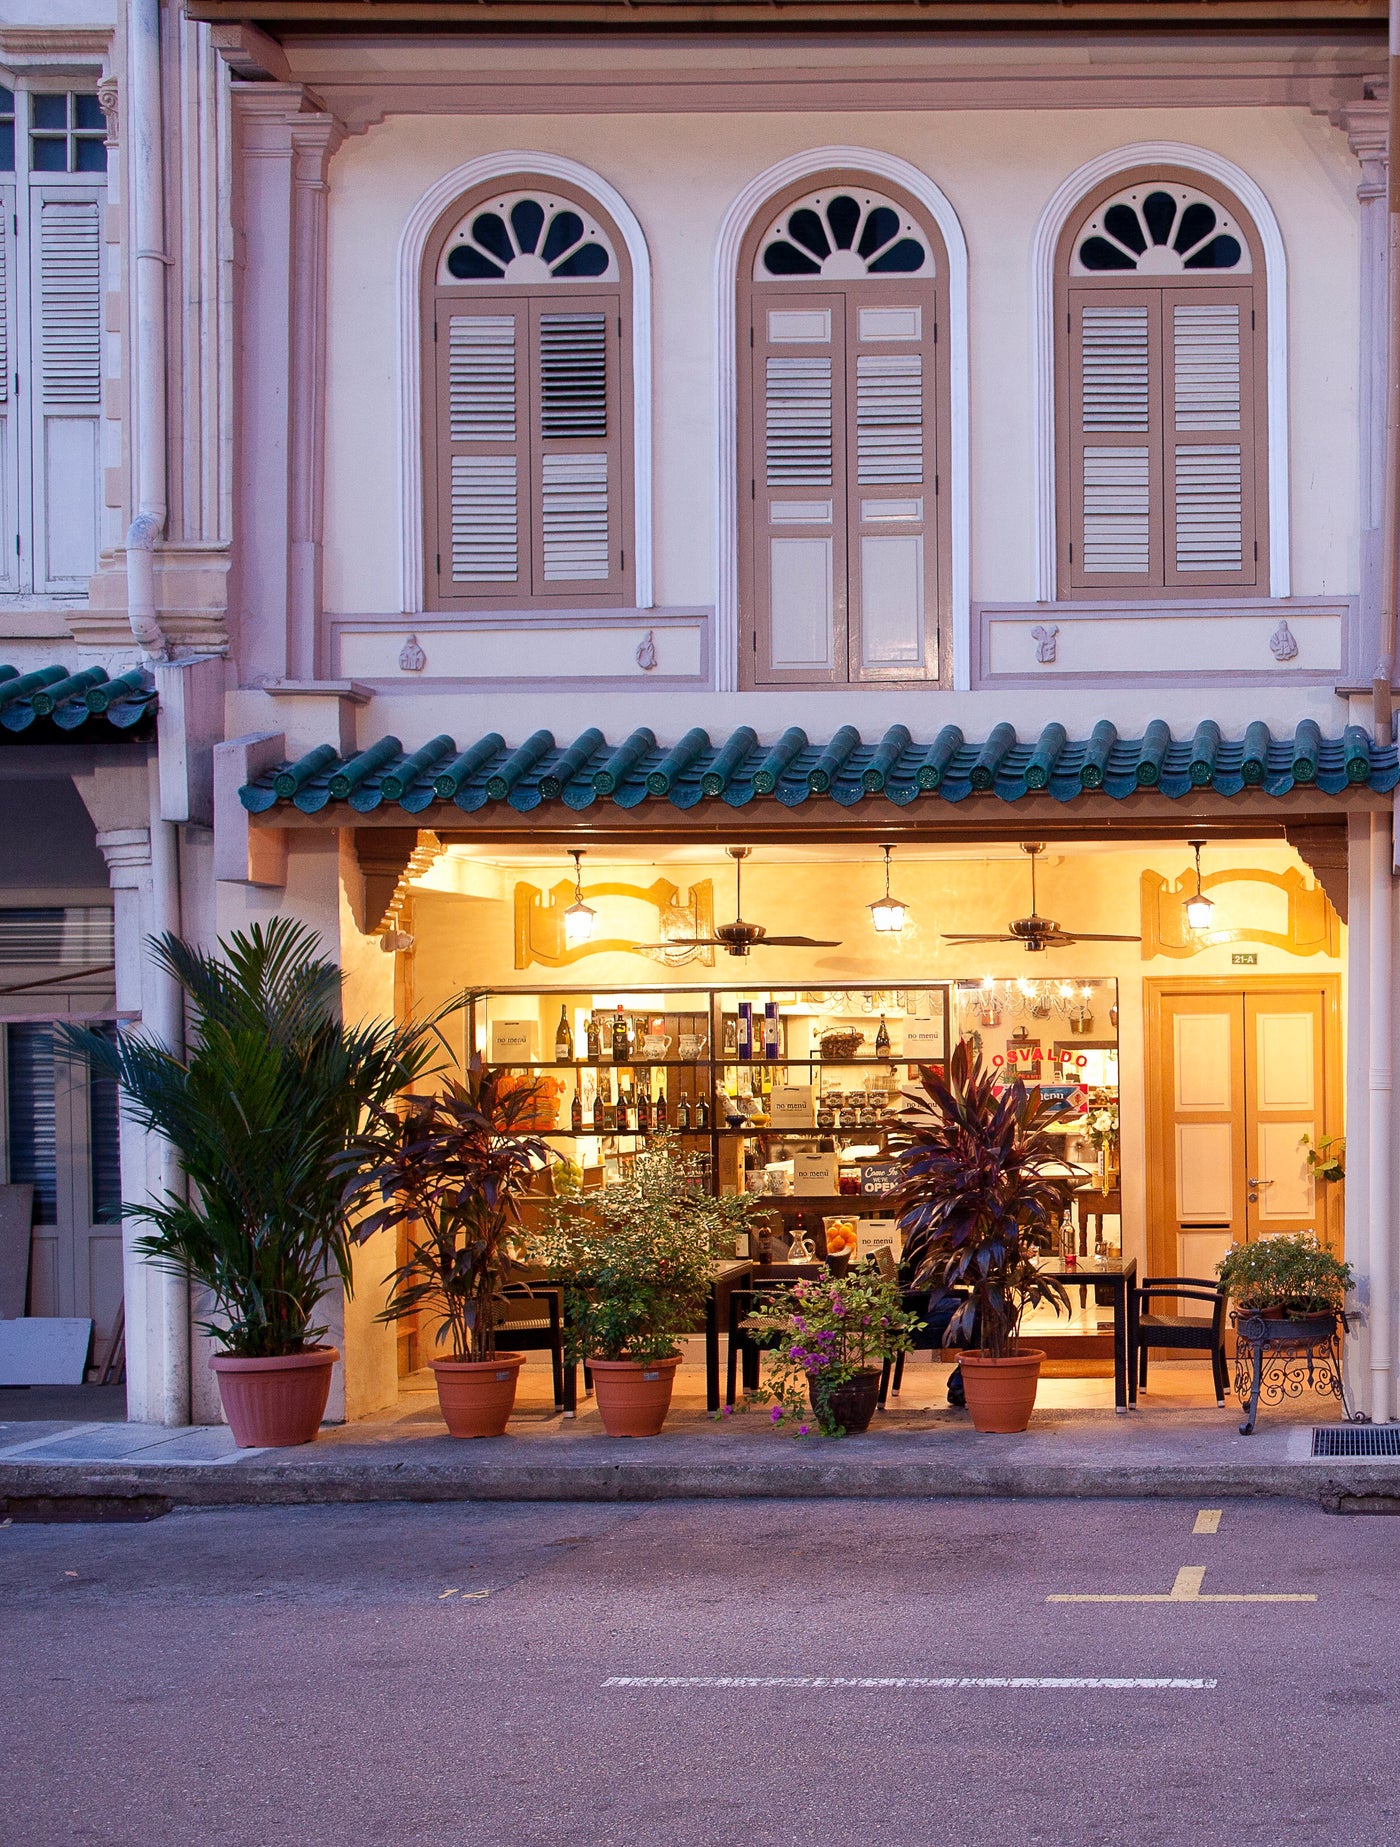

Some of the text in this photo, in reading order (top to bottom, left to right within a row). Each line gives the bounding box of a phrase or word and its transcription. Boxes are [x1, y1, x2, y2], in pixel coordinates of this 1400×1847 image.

[1234, 955, 1254, 964] 21-A
[991, 1047, 1088, 1067] OSVALDO
[865, 1166, 885, 1178] Come
